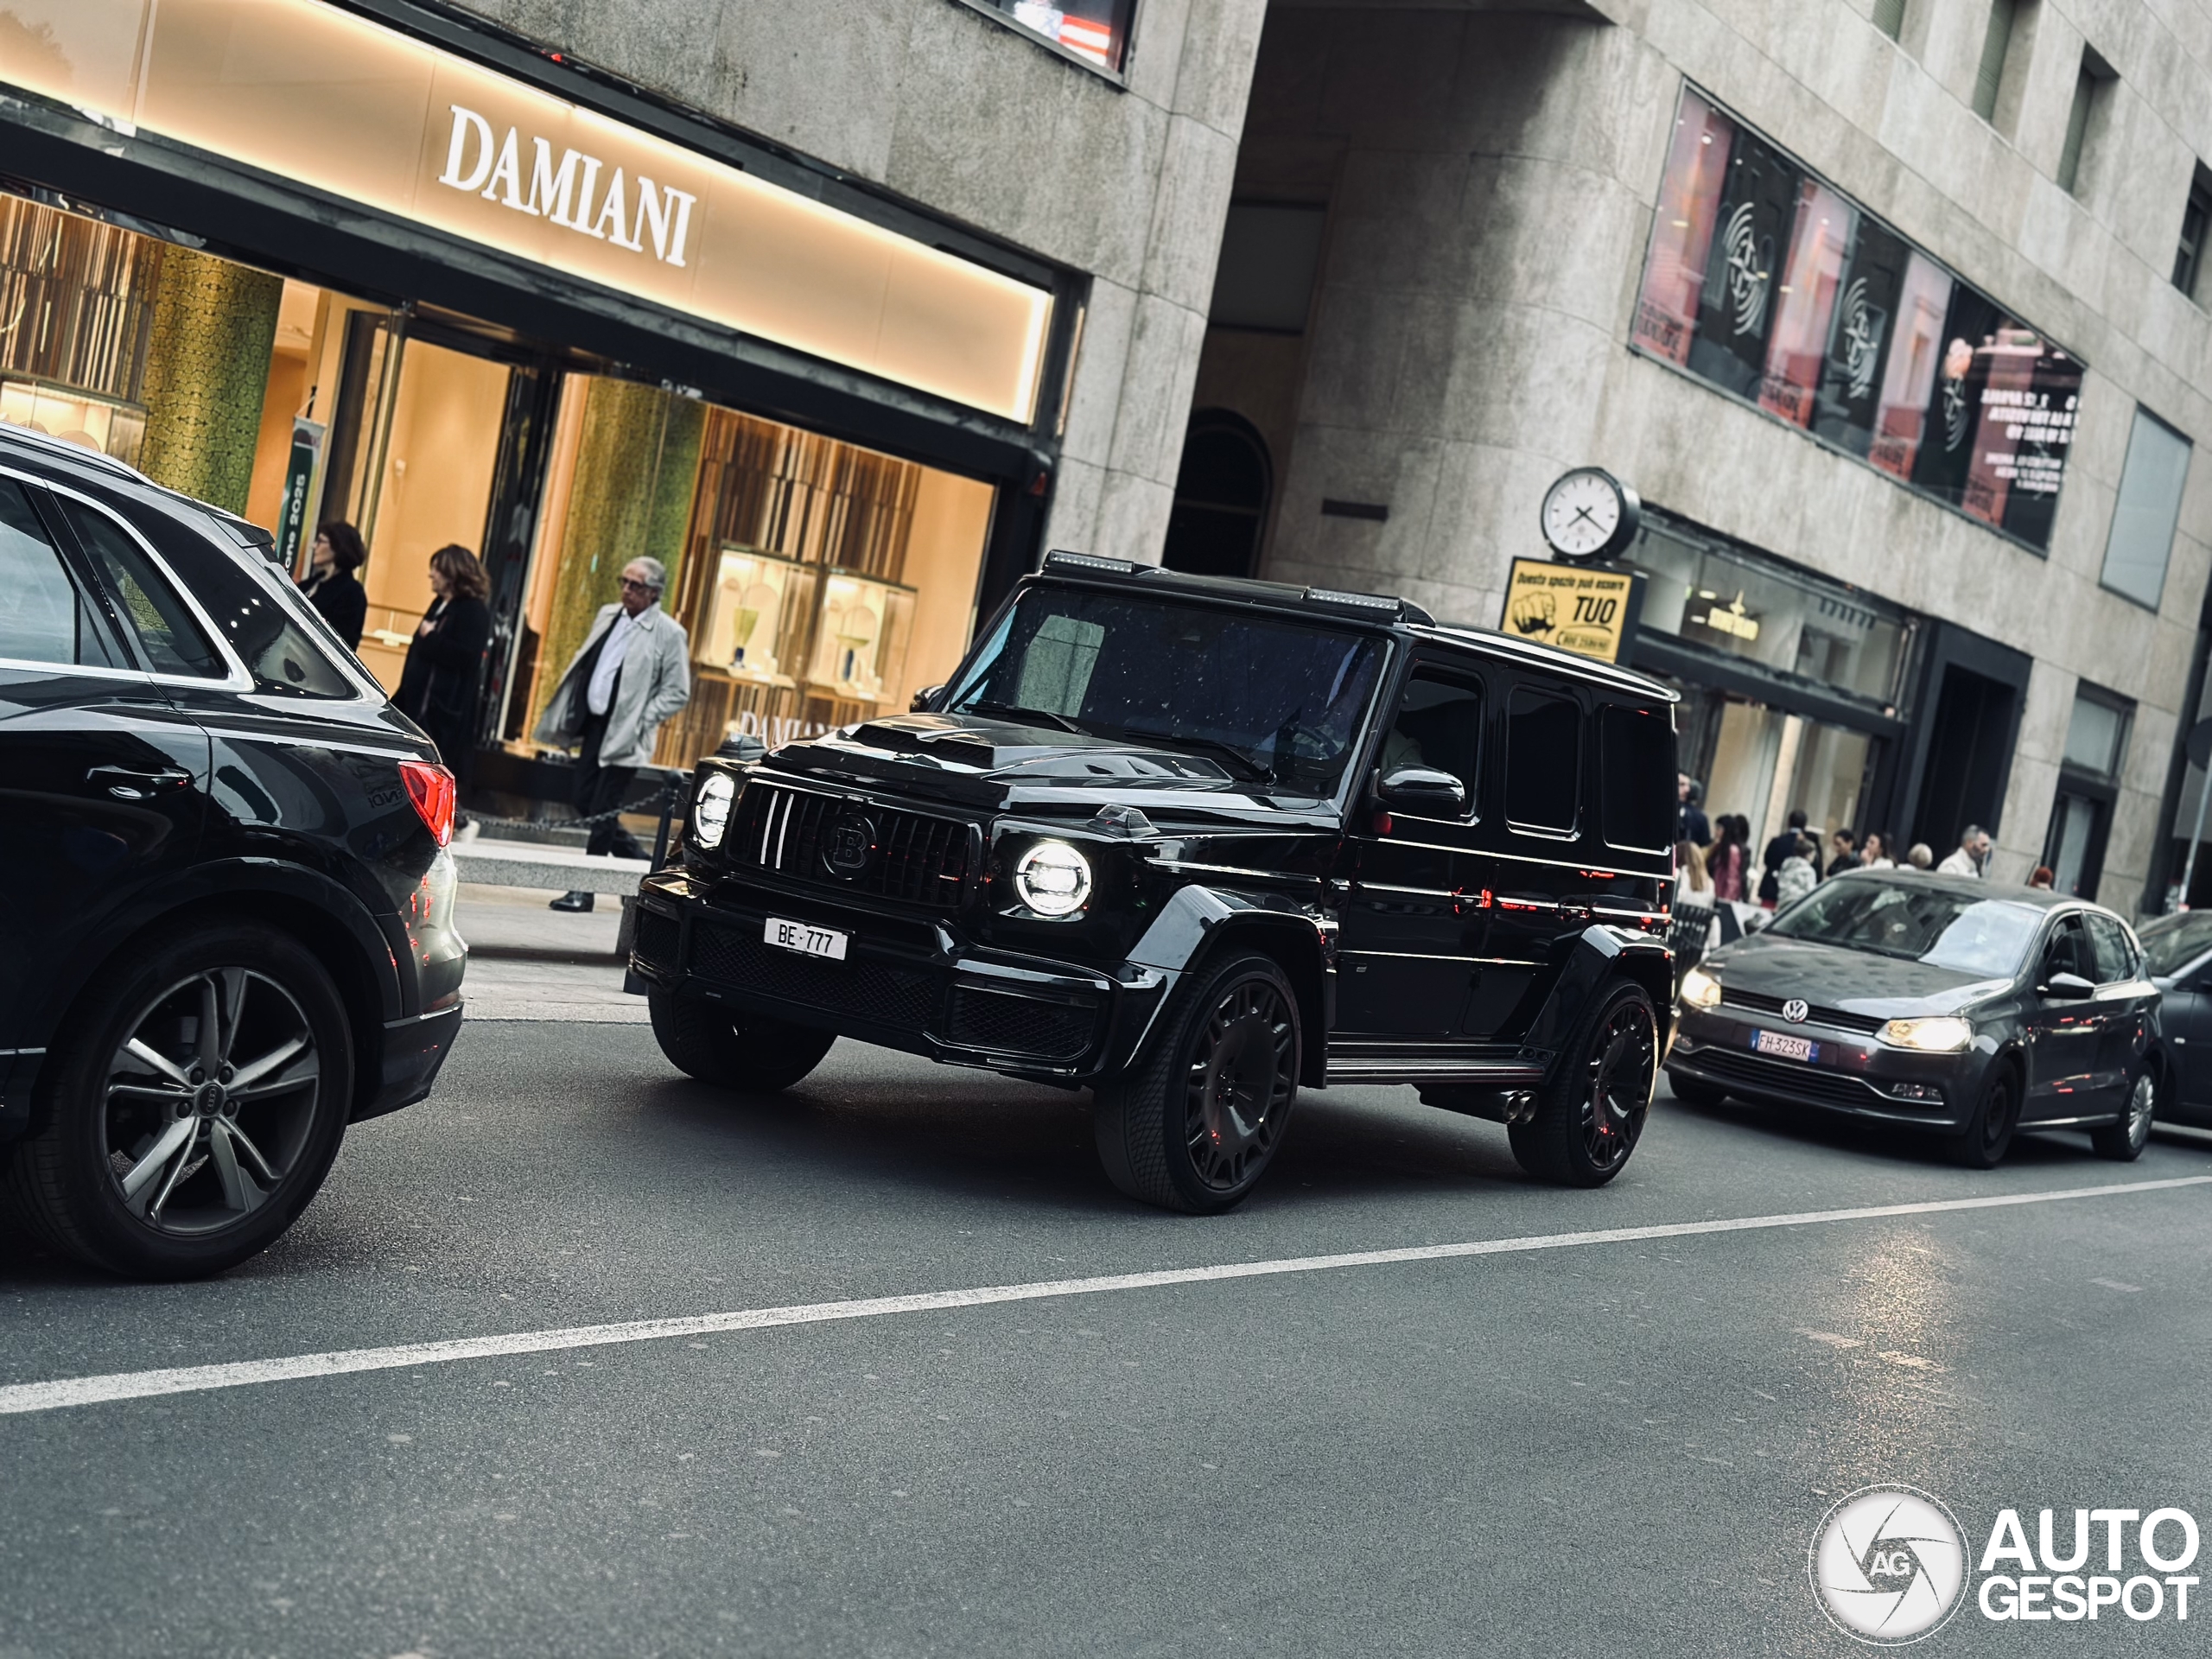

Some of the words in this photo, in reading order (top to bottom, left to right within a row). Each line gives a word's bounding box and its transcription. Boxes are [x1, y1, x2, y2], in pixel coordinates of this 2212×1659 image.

[438, 105, 696, 268] DAMIANI
[289, 474, 306, 526] 2025
[285, 531, 296, 572] one
[1573, 595, 1617, 624] TUO
